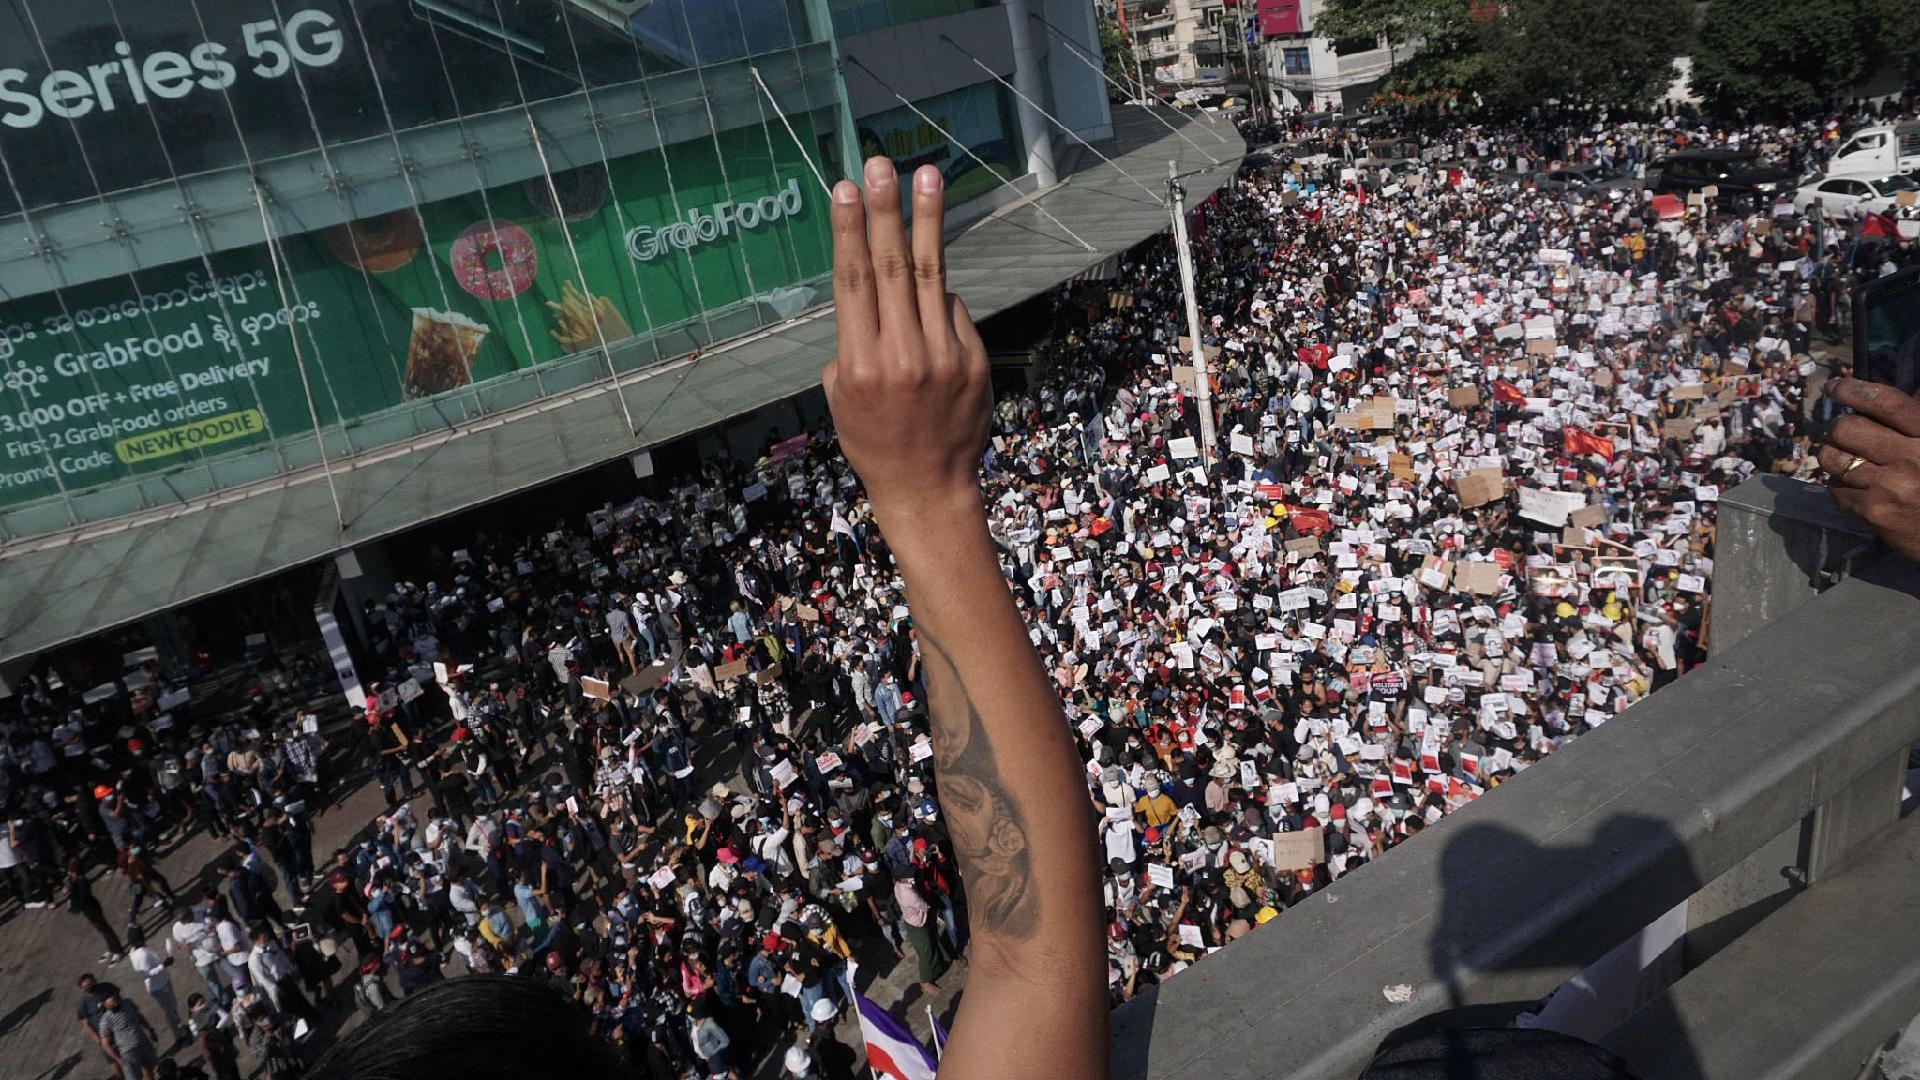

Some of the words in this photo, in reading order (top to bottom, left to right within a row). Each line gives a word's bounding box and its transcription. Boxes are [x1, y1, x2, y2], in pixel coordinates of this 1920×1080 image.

[0, 40, 237, 128] Series
[241, 8, 344, 78] 5G
[625, 178, 803, 262] GrabFood
[53, 322, 204, 377] GrabFood
[67, 391, 111, 416] OFF
[128, 379, 179, 403] Free
[180, 356, 270, 391] Delivery
[49, 432, 65, 449] 2
[65, 408, 161, 445] GrabFood
[164, 395, 228, 423] orders
[60, 450, 113, 474] Code
[125, 411, 254, 459] NEWFOODIE
